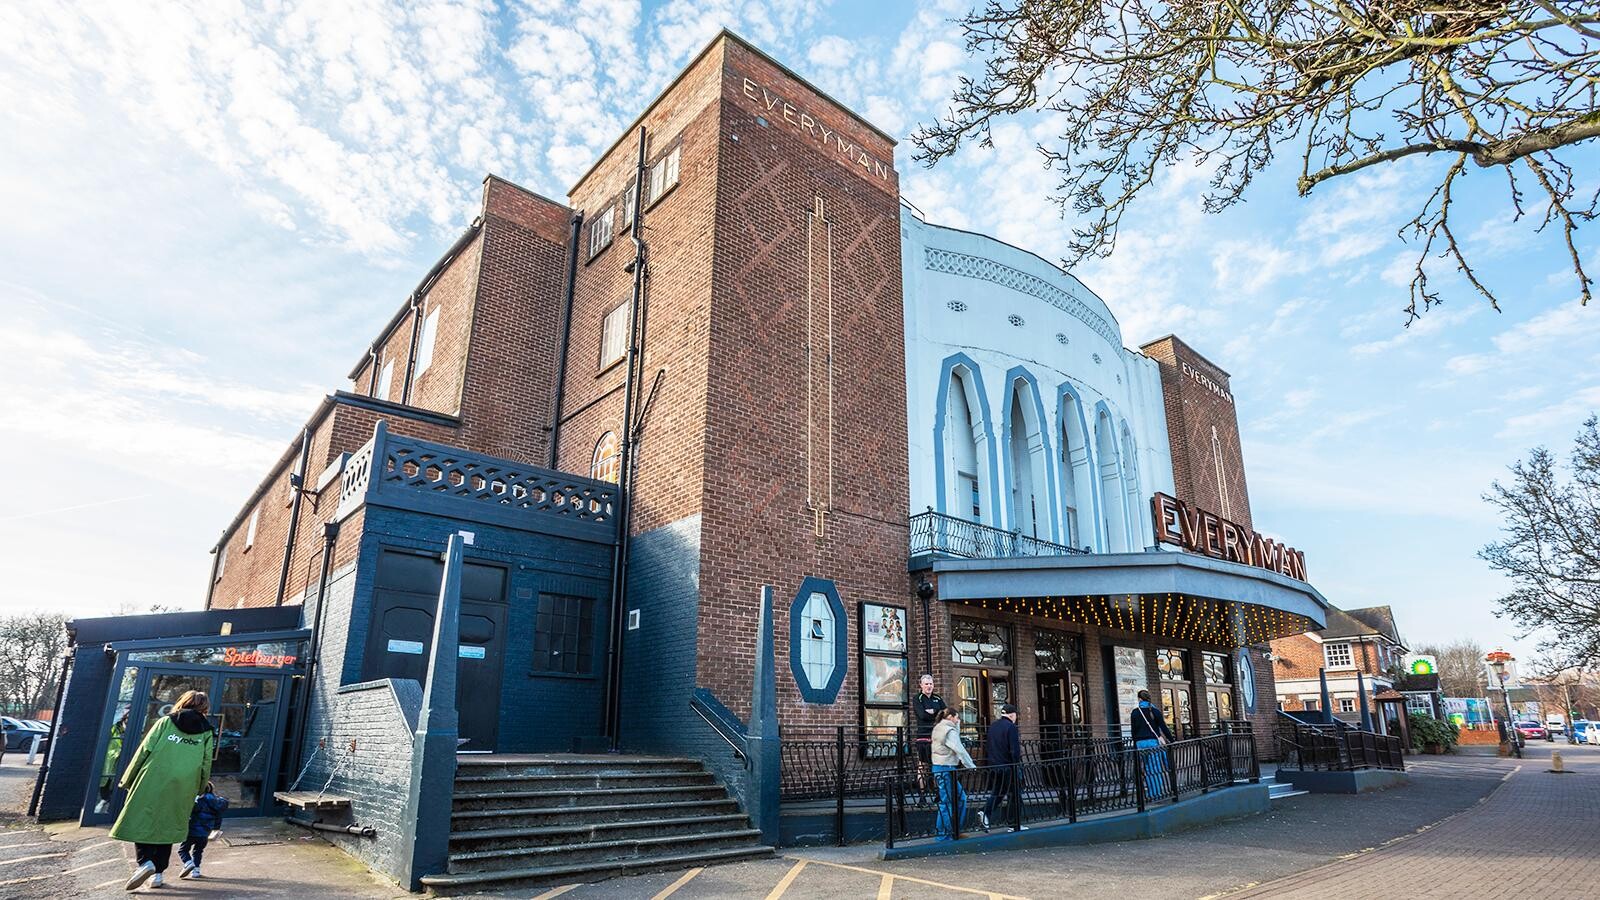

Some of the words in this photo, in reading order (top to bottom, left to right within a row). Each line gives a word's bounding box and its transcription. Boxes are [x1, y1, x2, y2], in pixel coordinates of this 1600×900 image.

[743, 77, 888, 181] EVERYMAN
[1182, 361, 1233, 404] EVERYMAN
[1153, 492, 1309, 583] EVERYMAN
[167, 733, 199, 746] dryrobe
